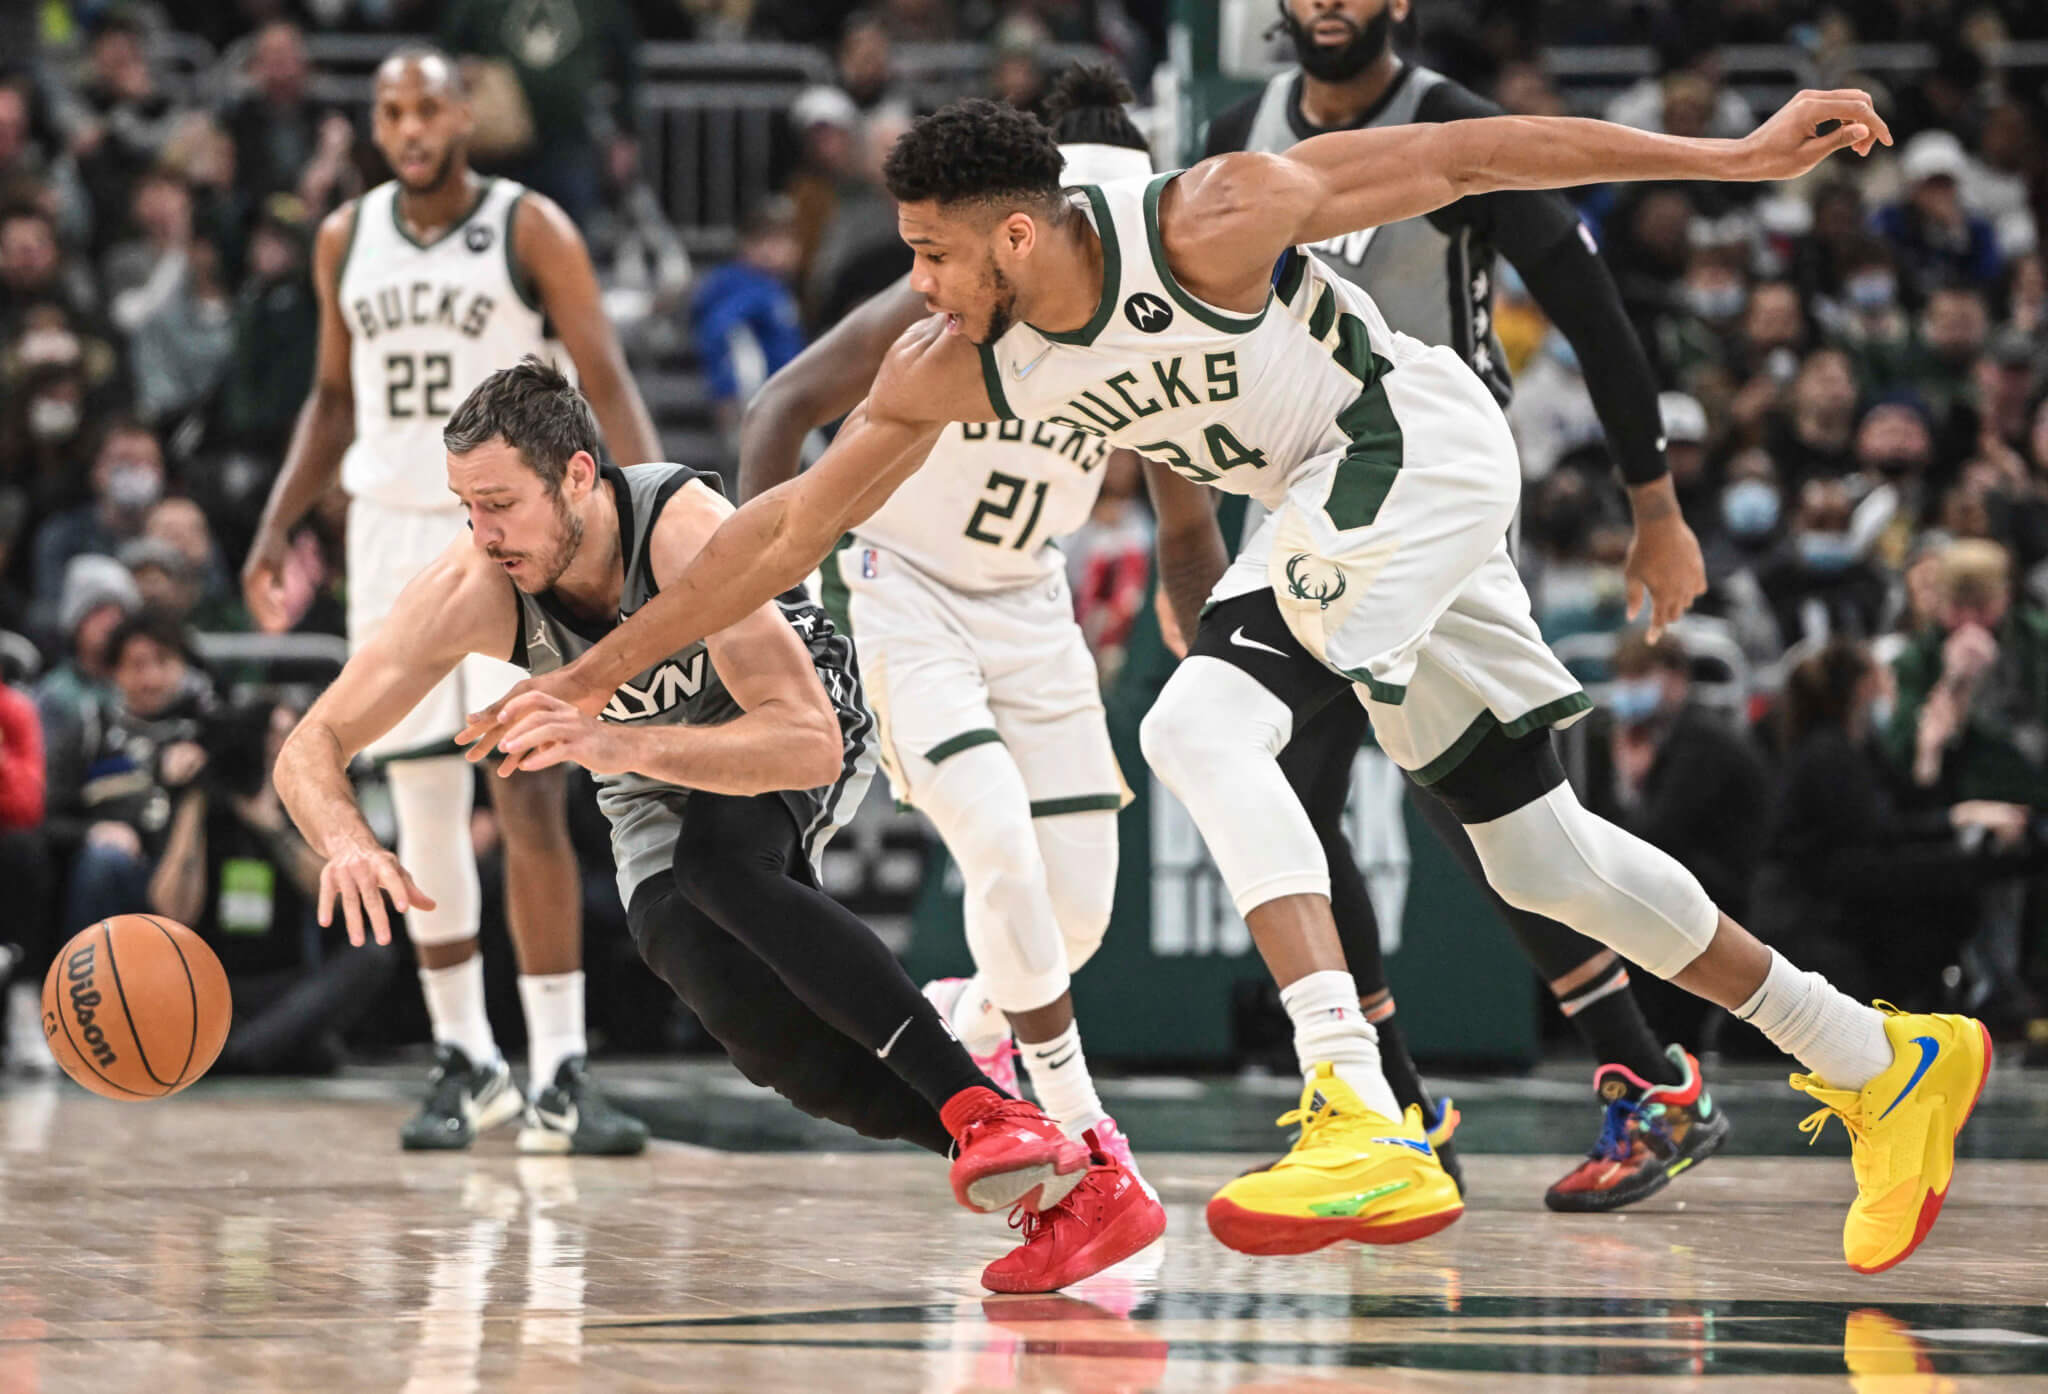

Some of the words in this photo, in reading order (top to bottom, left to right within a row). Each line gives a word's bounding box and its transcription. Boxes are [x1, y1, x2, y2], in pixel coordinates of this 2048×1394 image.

[354, 280, 496, 342] BUCKS
[386, 354, 452, 418] 22
[1046, 350, 1240, 438] BUCKS
[1134, 422, 1269, 482] 34
[963, 470, 1049, 550] 21
[597, 650, 706, 722] LYN
[67, 942, 118, 1069] Wilson
